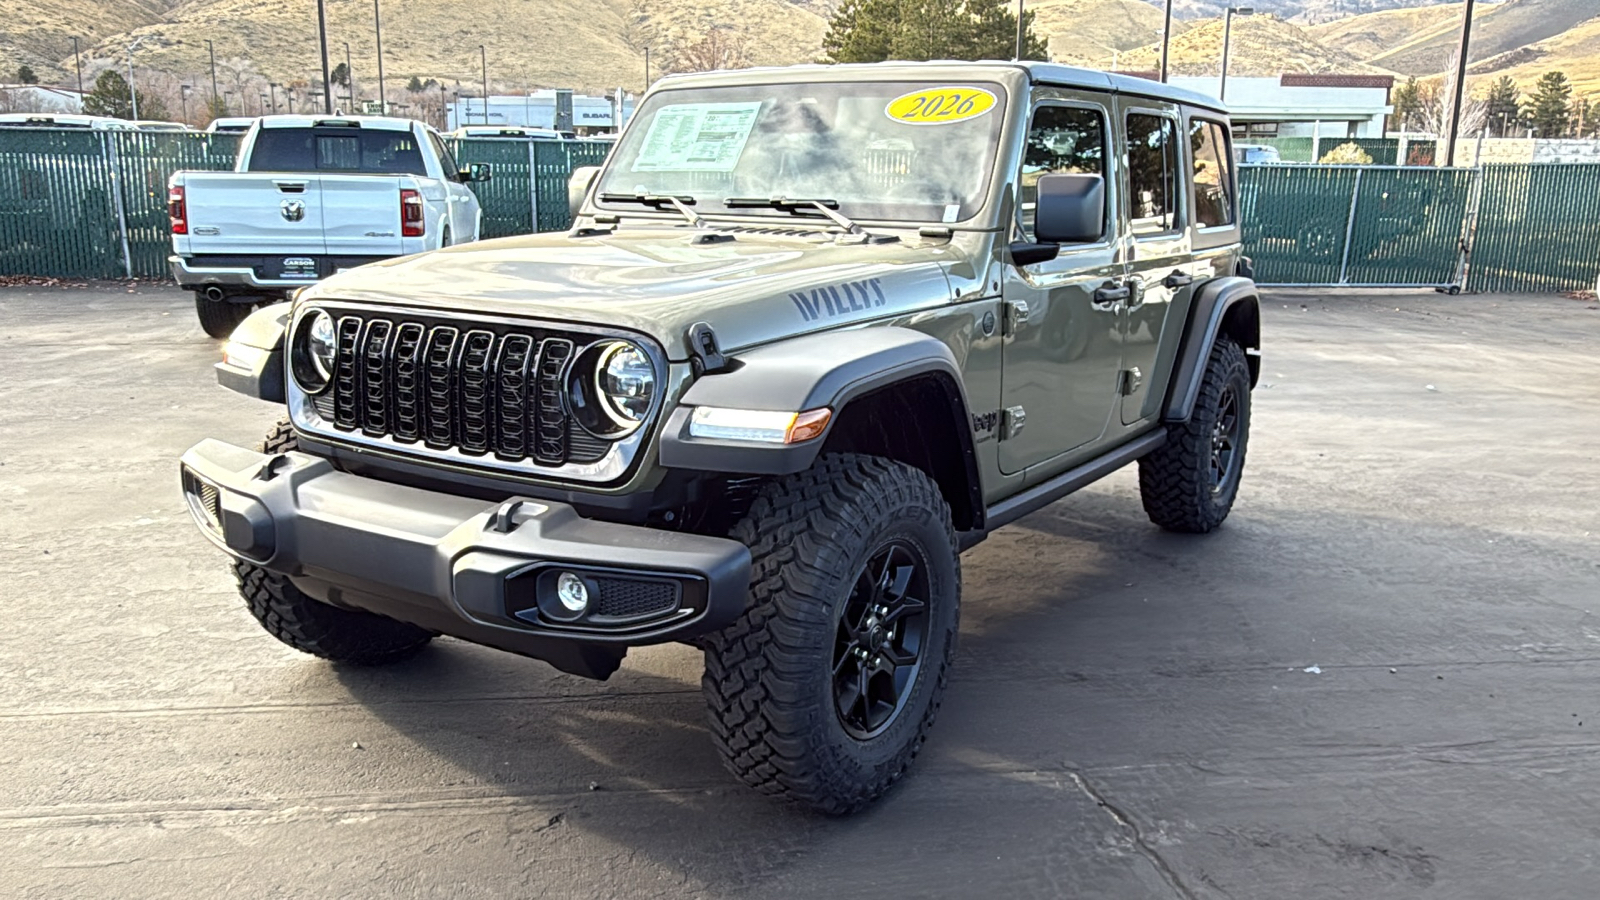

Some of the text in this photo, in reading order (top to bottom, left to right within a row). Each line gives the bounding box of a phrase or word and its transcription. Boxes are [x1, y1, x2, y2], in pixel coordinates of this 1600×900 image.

[902, 93, 982, 118] 2026
[283, 258, 315, 266] CARSON
[788, 277, 887, 322] WILLYS
